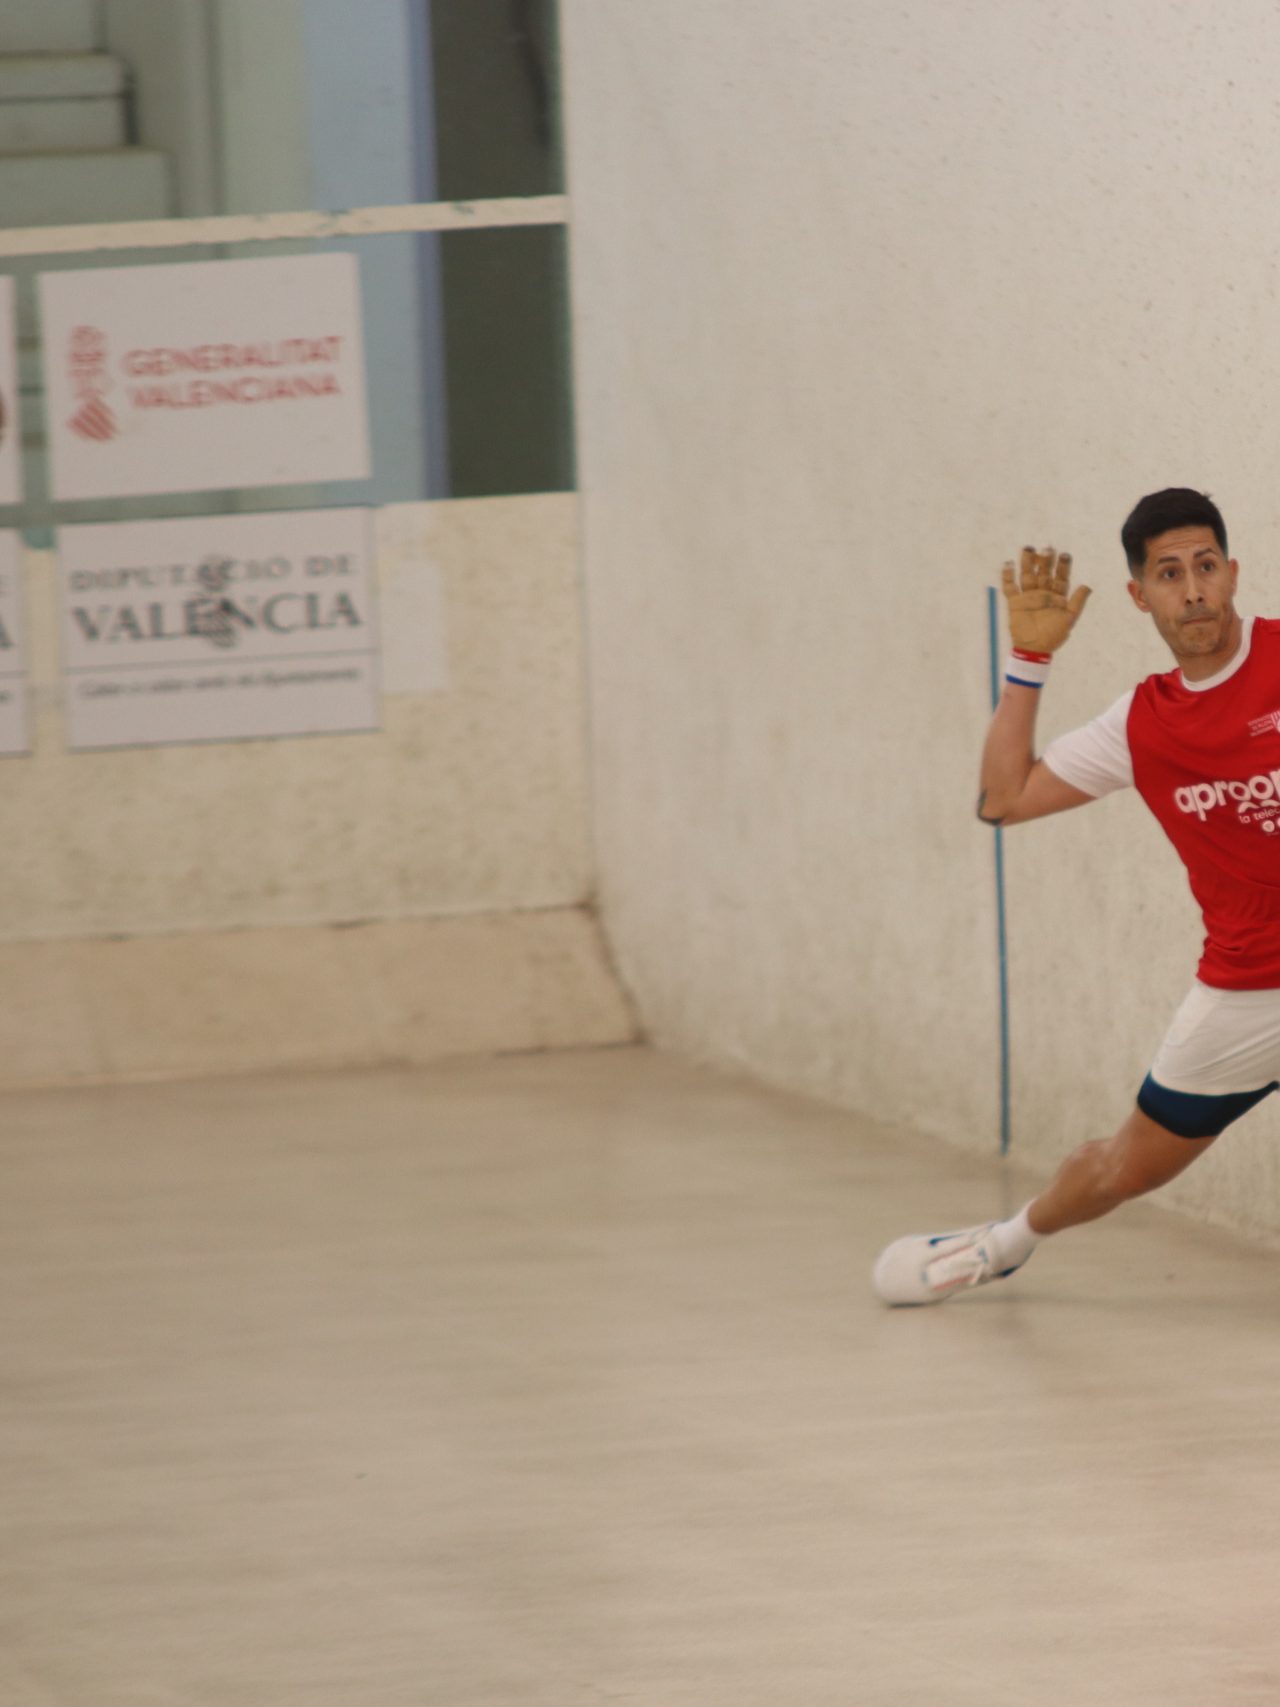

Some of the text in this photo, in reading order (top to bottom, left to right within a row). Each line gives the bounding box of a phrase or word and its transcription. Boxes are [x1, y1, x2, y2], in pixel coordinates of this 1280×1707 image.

[122, 336, 342, 376] GENERALITAT
[128, 375, 340, 410] VALENCIANA
[304, 554, 354, 578] DE
[1238, 814, 1251, 824] la
